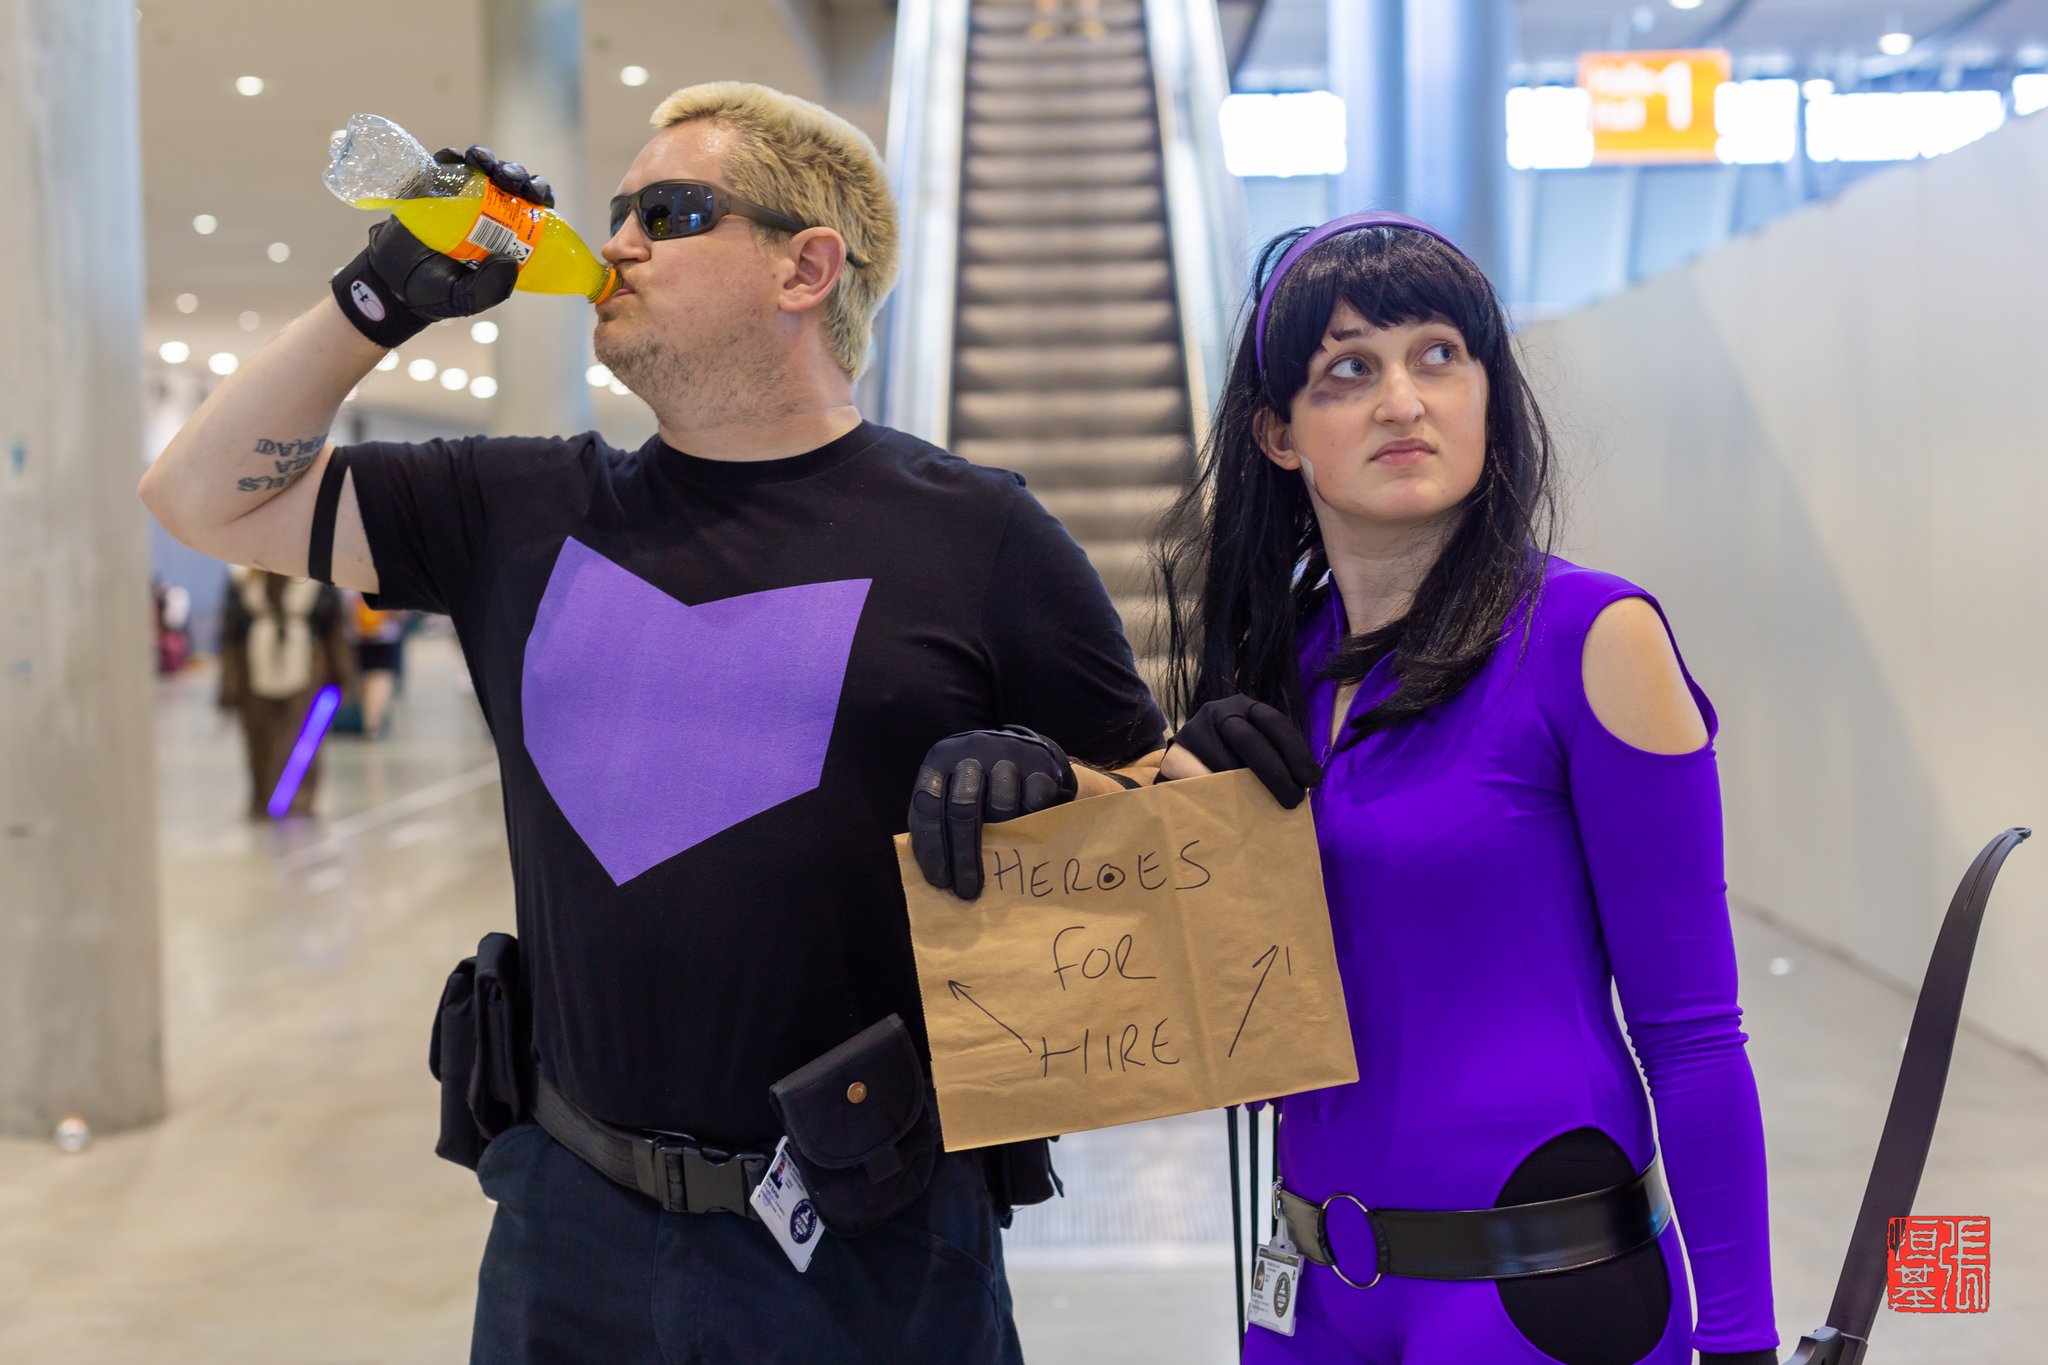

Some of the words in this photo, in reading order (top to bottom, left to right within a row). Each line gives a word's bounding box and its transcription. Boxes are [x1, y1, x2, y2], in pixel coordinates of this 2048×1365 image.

[1660, 61, 1692, 131] 1
[994, 839, 1211, 897] HEROES
[1053, 926, 1157, 991] FOR
[1040, 1017, 1180, 1077] HIRE
